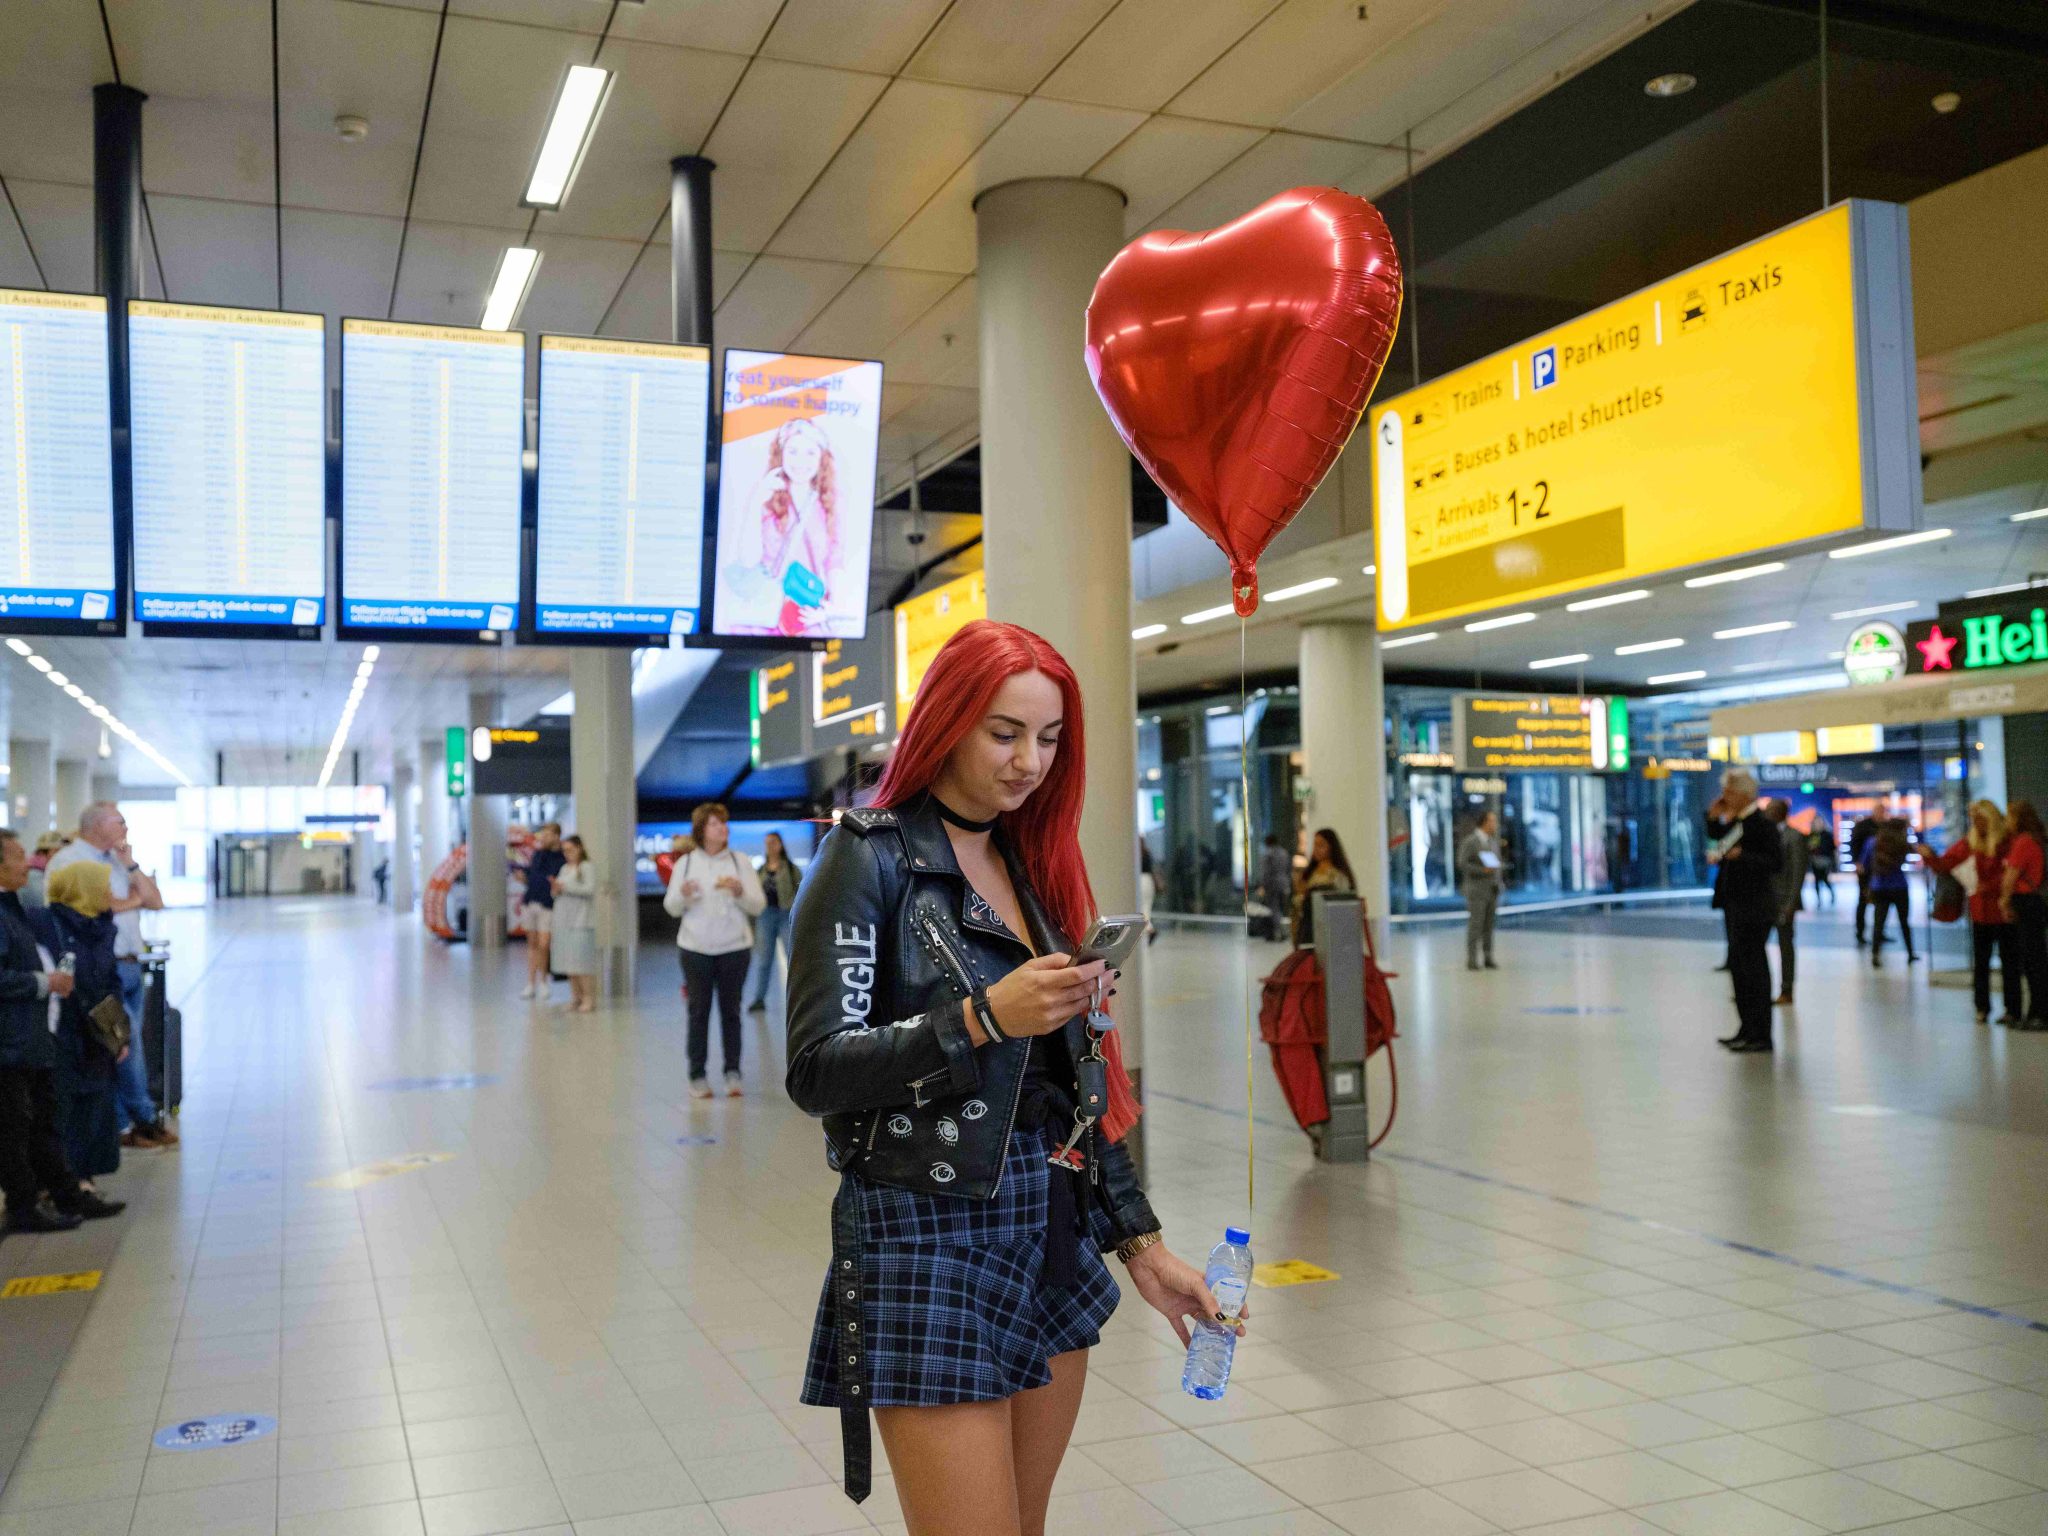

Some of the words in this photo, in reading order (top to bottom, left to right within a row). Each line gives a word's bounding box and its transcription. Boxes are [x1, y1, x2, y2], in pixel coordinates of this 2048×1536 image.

[1719, 264, 1782, 306] Taxis
[725, 368, 763, 387] reat
[1534, 353, 1553, 388] P
[1564, 325, 1641, 369] Parking
[1453, 380, 1503, 414] Trains
[1454, 443, 1501, 474] Buses
[1507, 432, 1520, 456] &
[1525, 410, 1573, 449] hotel
[1580, 384, 1664, 431] shuttles
[1437, 490, 1500, 528] Arrivals
[1507, 480, 1551, 526] 1-2
[1962, 607, 2048, 668] Hei
